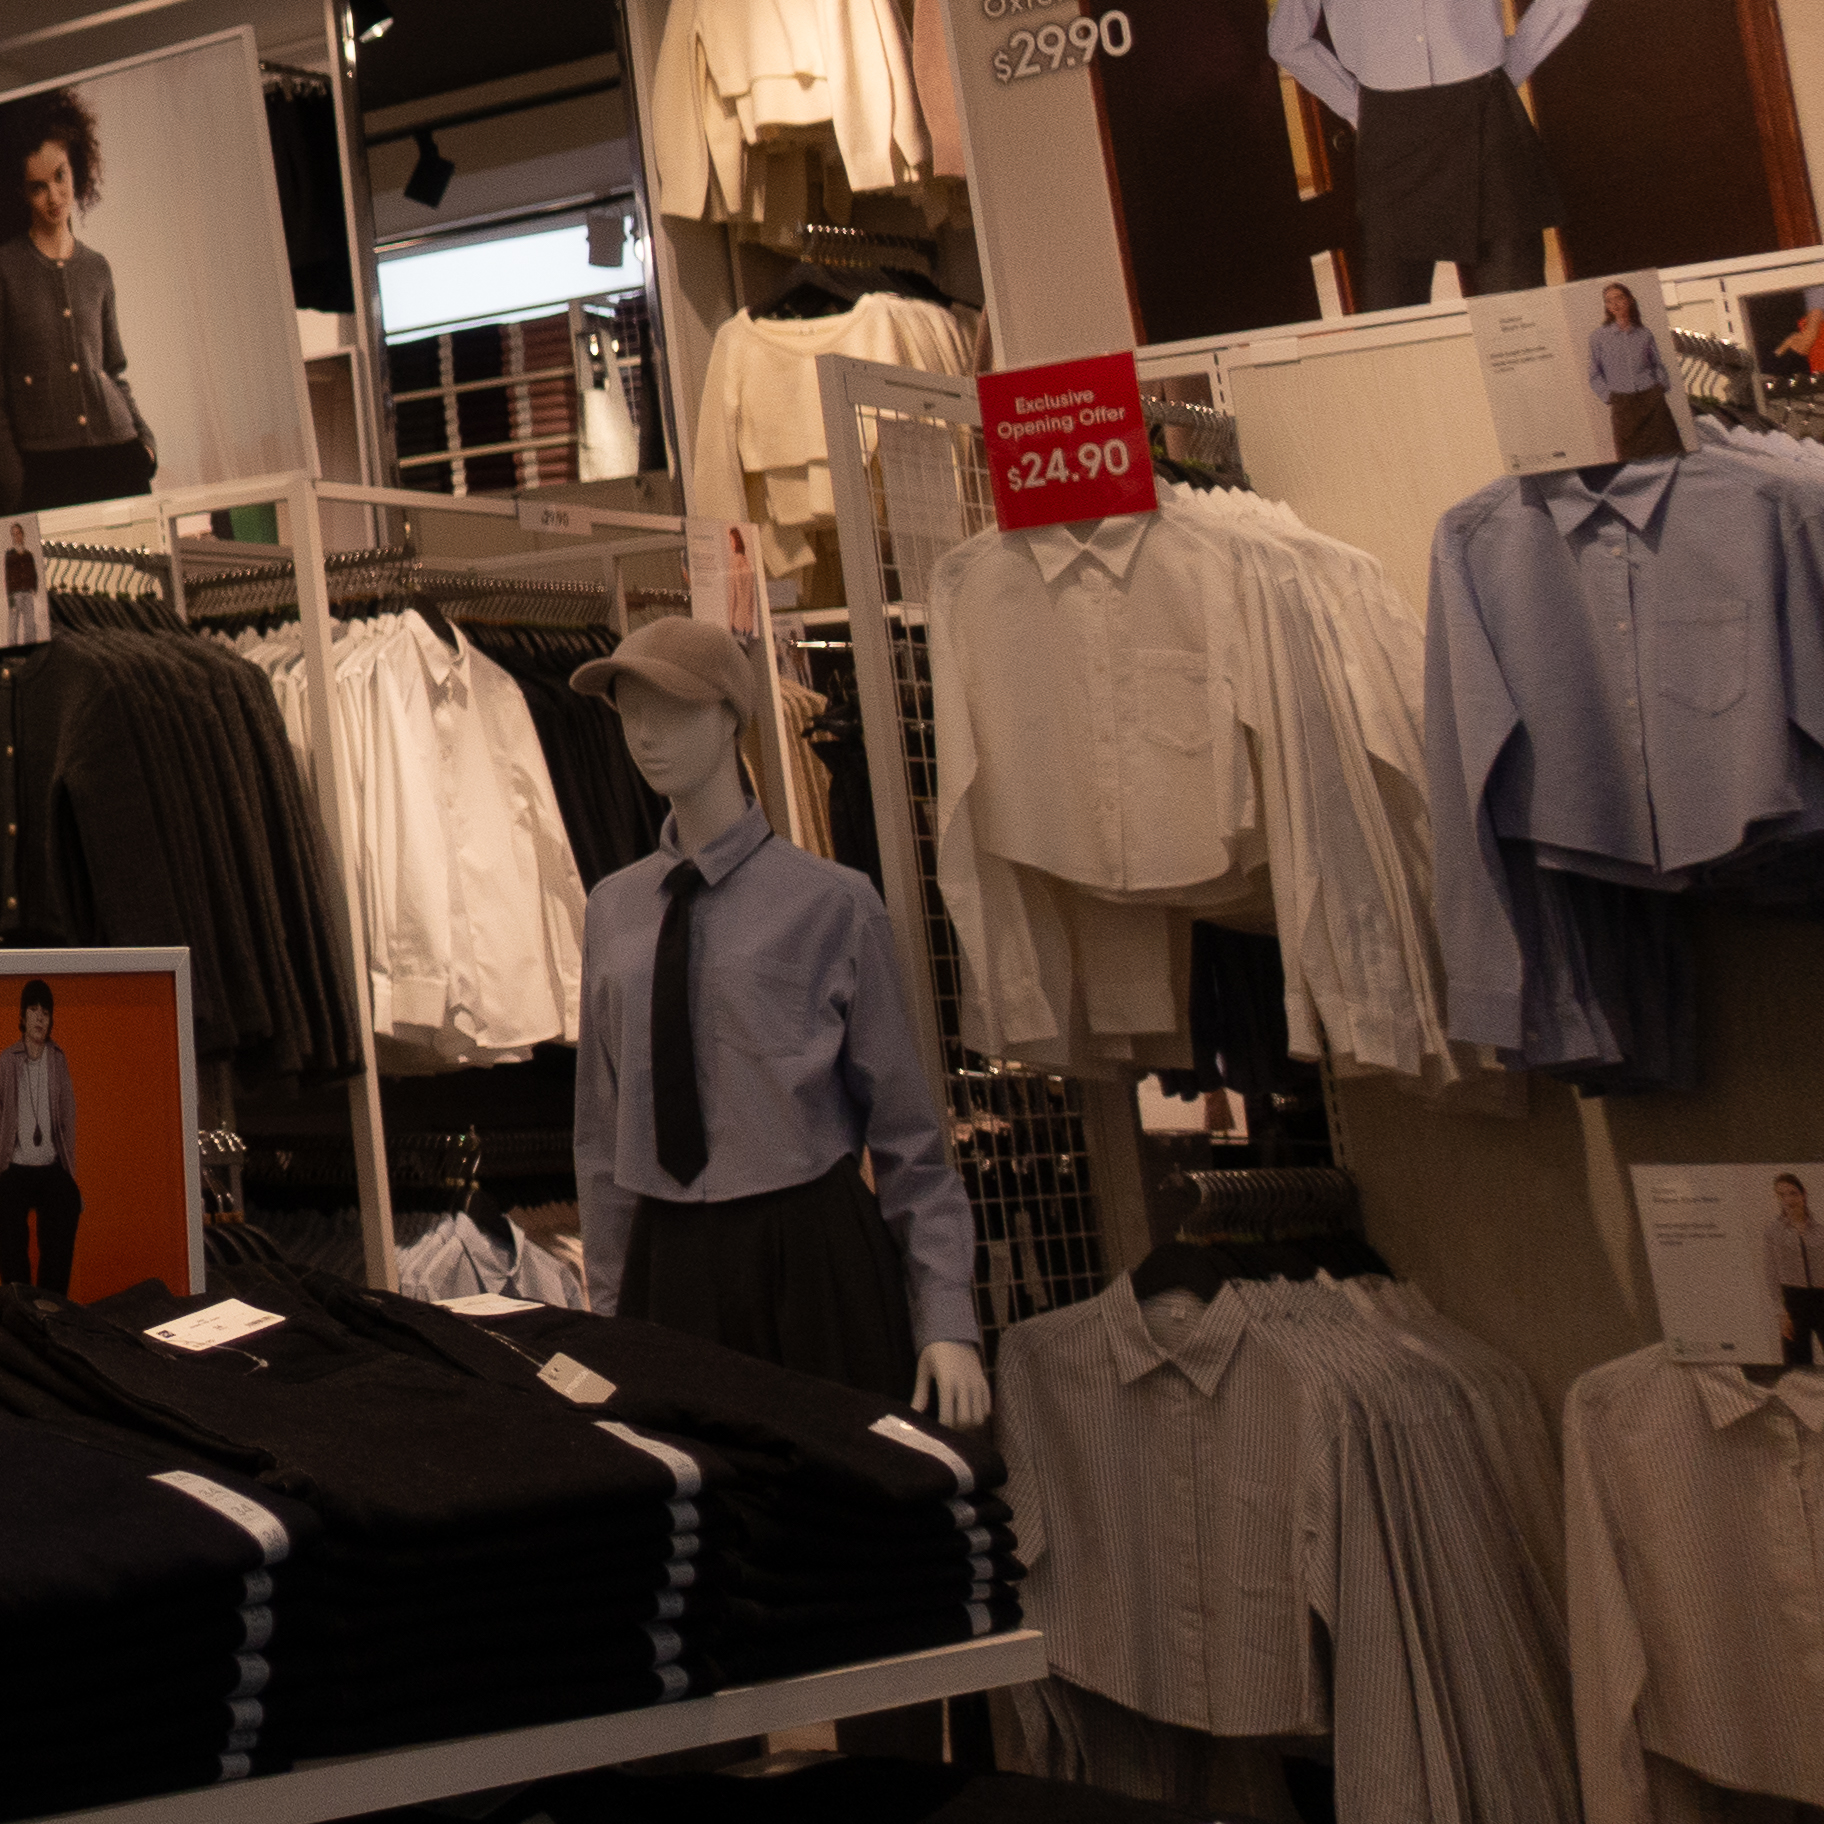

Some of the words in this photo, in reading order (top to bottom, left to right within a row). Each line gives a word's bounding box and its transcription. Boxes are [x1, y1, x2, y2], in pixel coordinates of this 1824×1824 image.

[993, 9, 1132, 84] $29.90
[997, 414, 1075, 442] Opening
[1078, 406, 1126, 427] Offer
[1014, 389, 1095, 415] Exclusive
[1007, 438, 1130, 493] $24.90
